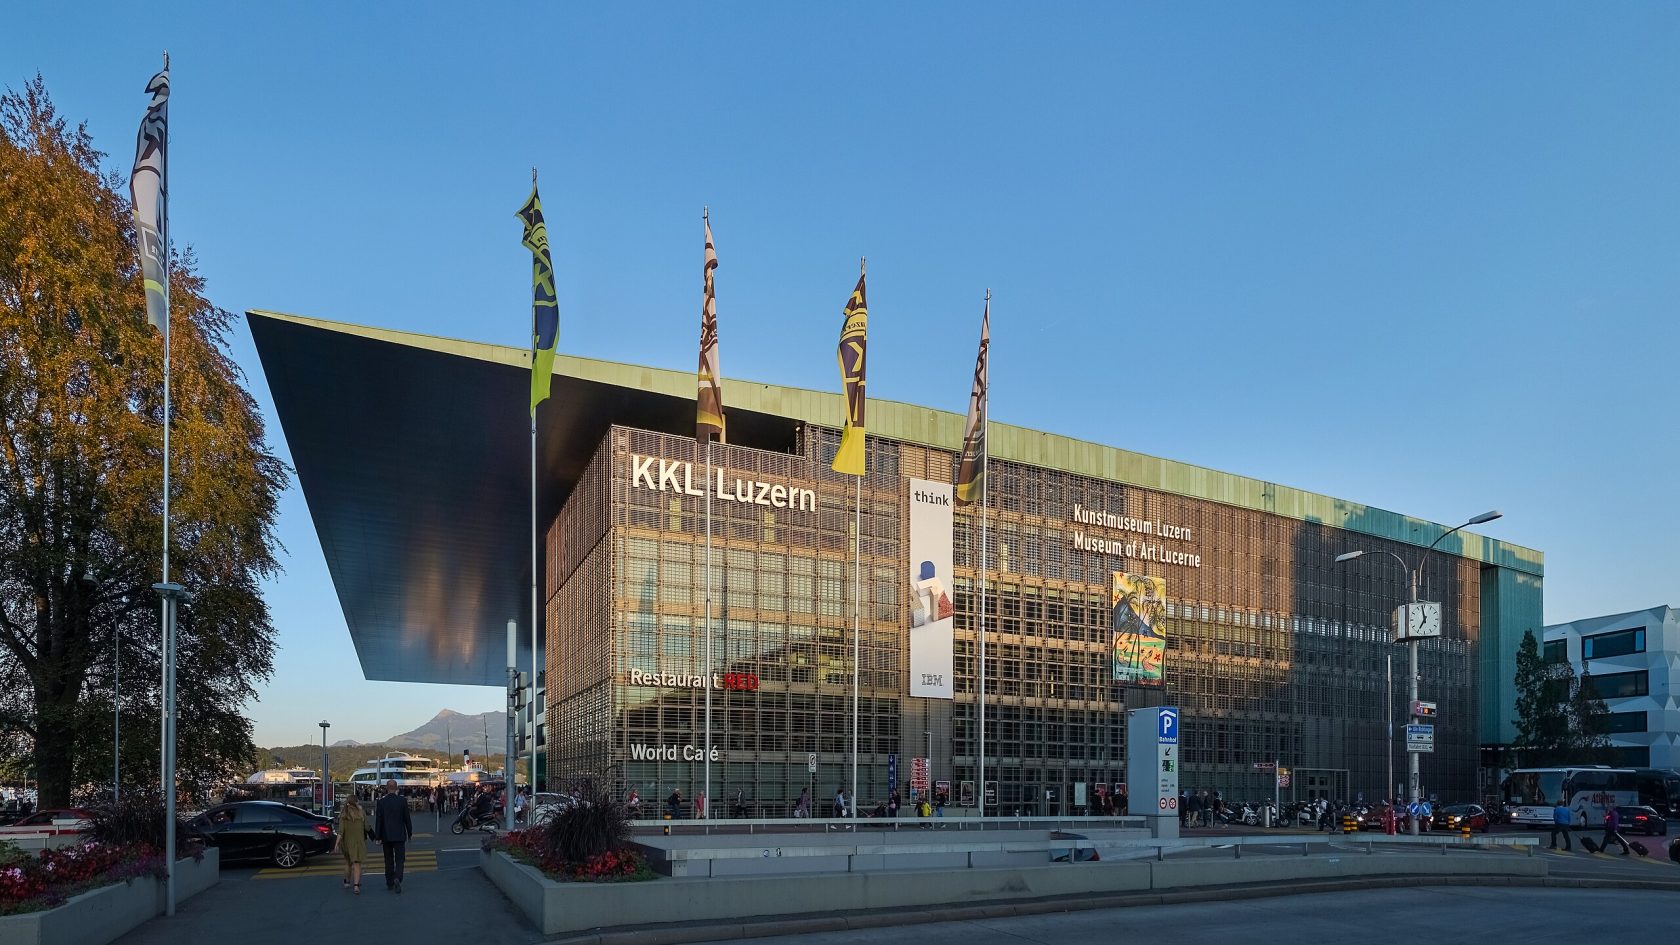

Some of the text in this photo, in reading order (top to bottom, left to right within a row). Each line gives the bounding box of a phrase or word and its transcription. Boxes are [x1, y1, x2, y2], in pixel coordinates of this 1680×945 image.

[632, 455, 816, 512] KKL Luzern
[914, 491, 949, 507] think
[1074, 504, 1191, 541] Kunstmuseum Luzern
[1074, 531, 1200, 567] Museum of Art Lucerne
[724, 673, 759, 691] RED
[922, 674, 943, 686] IBM
[1164, 716, 1172, 734] P
[630, 743, 719, 761] World Caé
